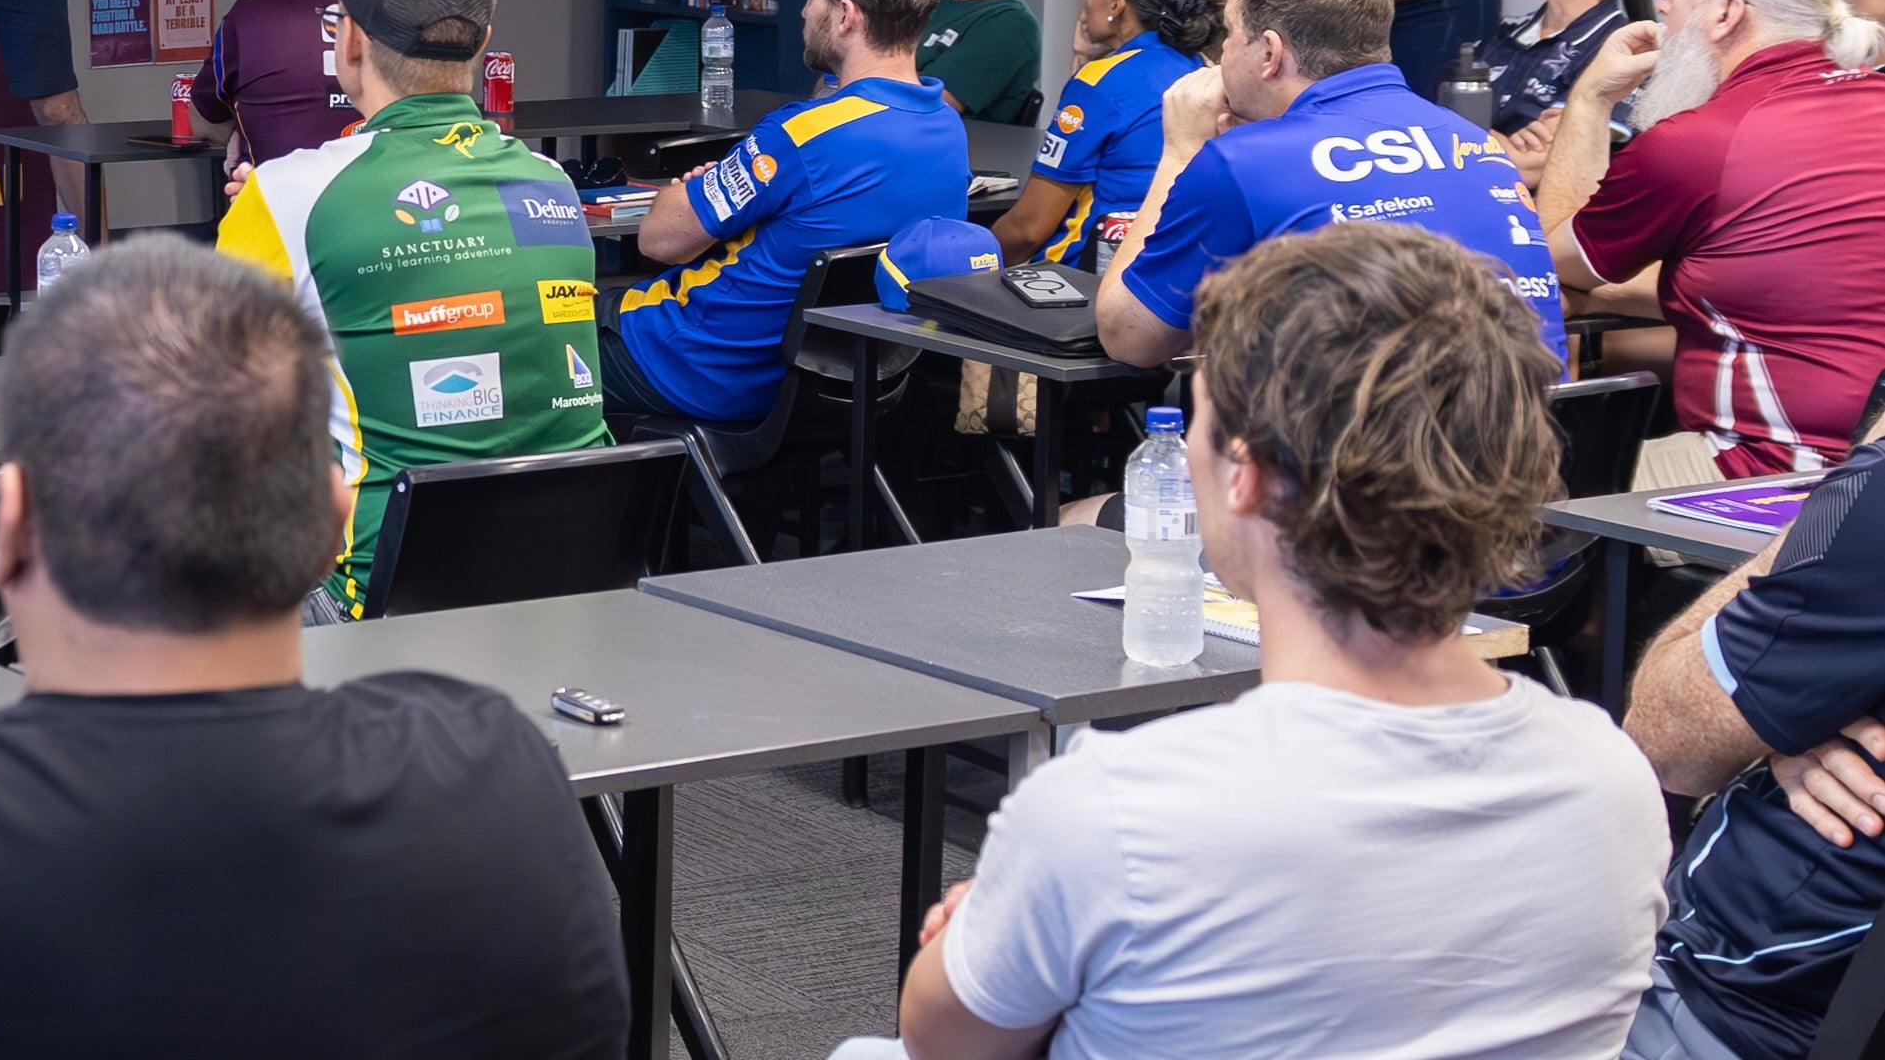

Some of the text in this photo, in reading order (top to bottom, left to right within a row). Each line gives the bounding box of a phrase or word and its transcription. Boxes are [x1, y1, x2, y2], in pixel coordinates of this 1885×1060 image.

[176, 5, 188, 17] BE
[166, 17, 205, 30] TERRIBLE
[1311, 126, 1446, 182] CSI
[522, 198, 579, 220] Define
[1348, 195, 1434, 220] Safekon
[382, 236, 486, 259] SANCTUARY
[357, 246, 513, 276] early learning adventure
[546, 286, 578, 299] JAX
[404, 302, 494, 326] huffgroup
[422, 406, 501, 424] FINANCE
